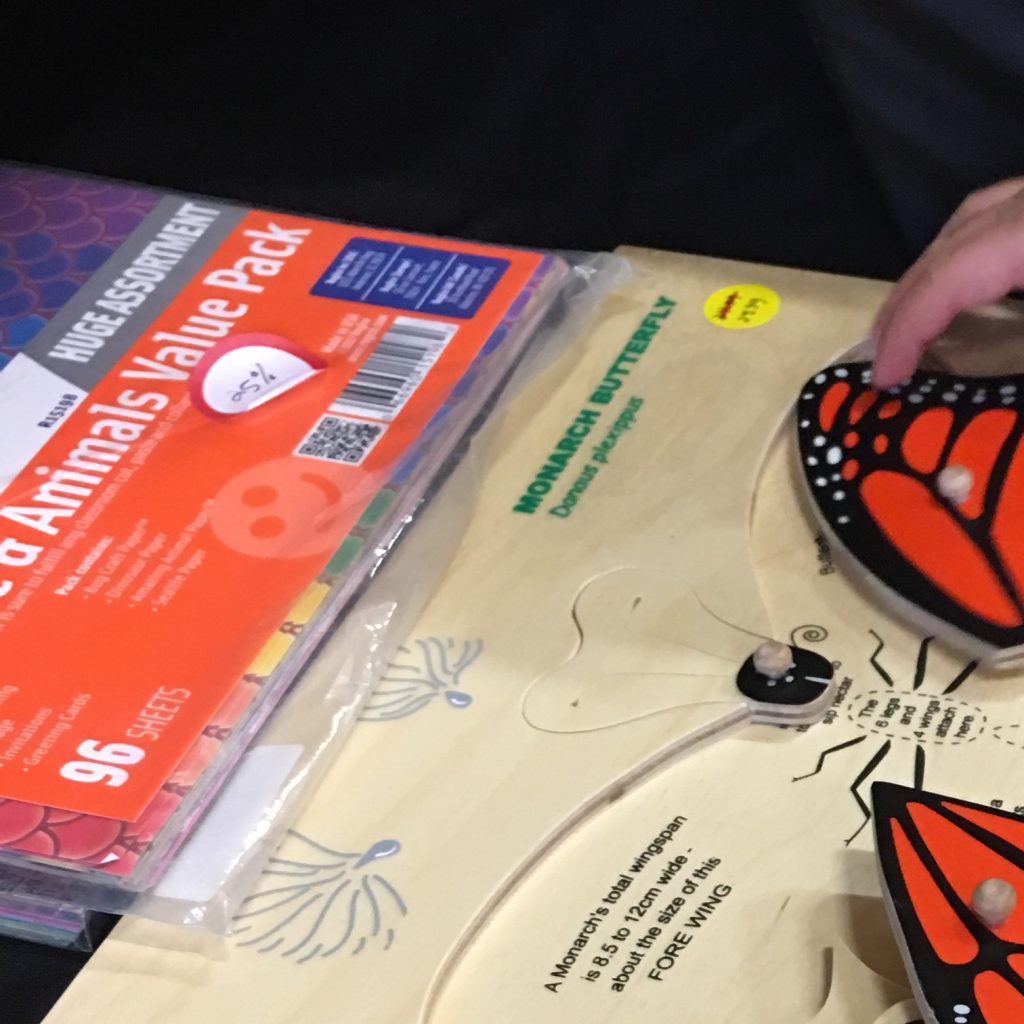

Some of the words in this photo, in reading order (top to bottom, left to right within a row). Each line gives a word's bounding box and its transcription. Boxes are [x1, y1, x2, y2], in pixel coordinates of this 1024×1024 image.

[48, 300, 110, 362] HUGE
[103, 202, 220, 313] ASSORTMENT
[0, 389, 170, 534] Animals
[120, 298, 247, 381] Value
[205, 222, 312, 294] Pack
[512, 409, 602, 514] MONARCH
[590, 295, 677, 404] BUTTERFLY
[548, 464, 598, 518] Danaus
[592, 396, 644, 464] plexippus
[54, 576, 80, 595] Pack
[832, 676, 854, 708] nectar
[858, 699, 879, 718] The
[880, 697, 900, 719] legs
[901, 705, 917, 725] and
[3, 708, 53, 761] Invitations
[23, 722, 72, 765] Greeting
[59, 693, 91, 722] Cards
[60, 739, 146, 787] 96
[126, 686, 191, 741] SHEETS
[875, 719, 889, 729] 6
[914, 730, 925, 738] 4
[921, 700, 941, 729] wings
[936, 706, 958, 738] attach
[954, 715, 975, 738] here
[629, 815, 688, 873] wingspan
[602, 874, 635, 904] total
[550, 906, 610, 979] Monarch's
[580, 969, 601, 982] is
[592, 943, 619, 967] 8.5
[611, 927, 631, 942] to
[624, 887, 662, 923] 12cm
[657, 855, 688, 885] wide
[611, 951, 645, 992] about
[636, 926, 662, 950] the
[657, 896, 686, 924] size
[681, 878, 700, 895] of
[692, 856, 722, 880] this
[647, 931, 694, 982] FORE
[684, 883, 733, 929] WING
[544, 981, 563, 993] A
